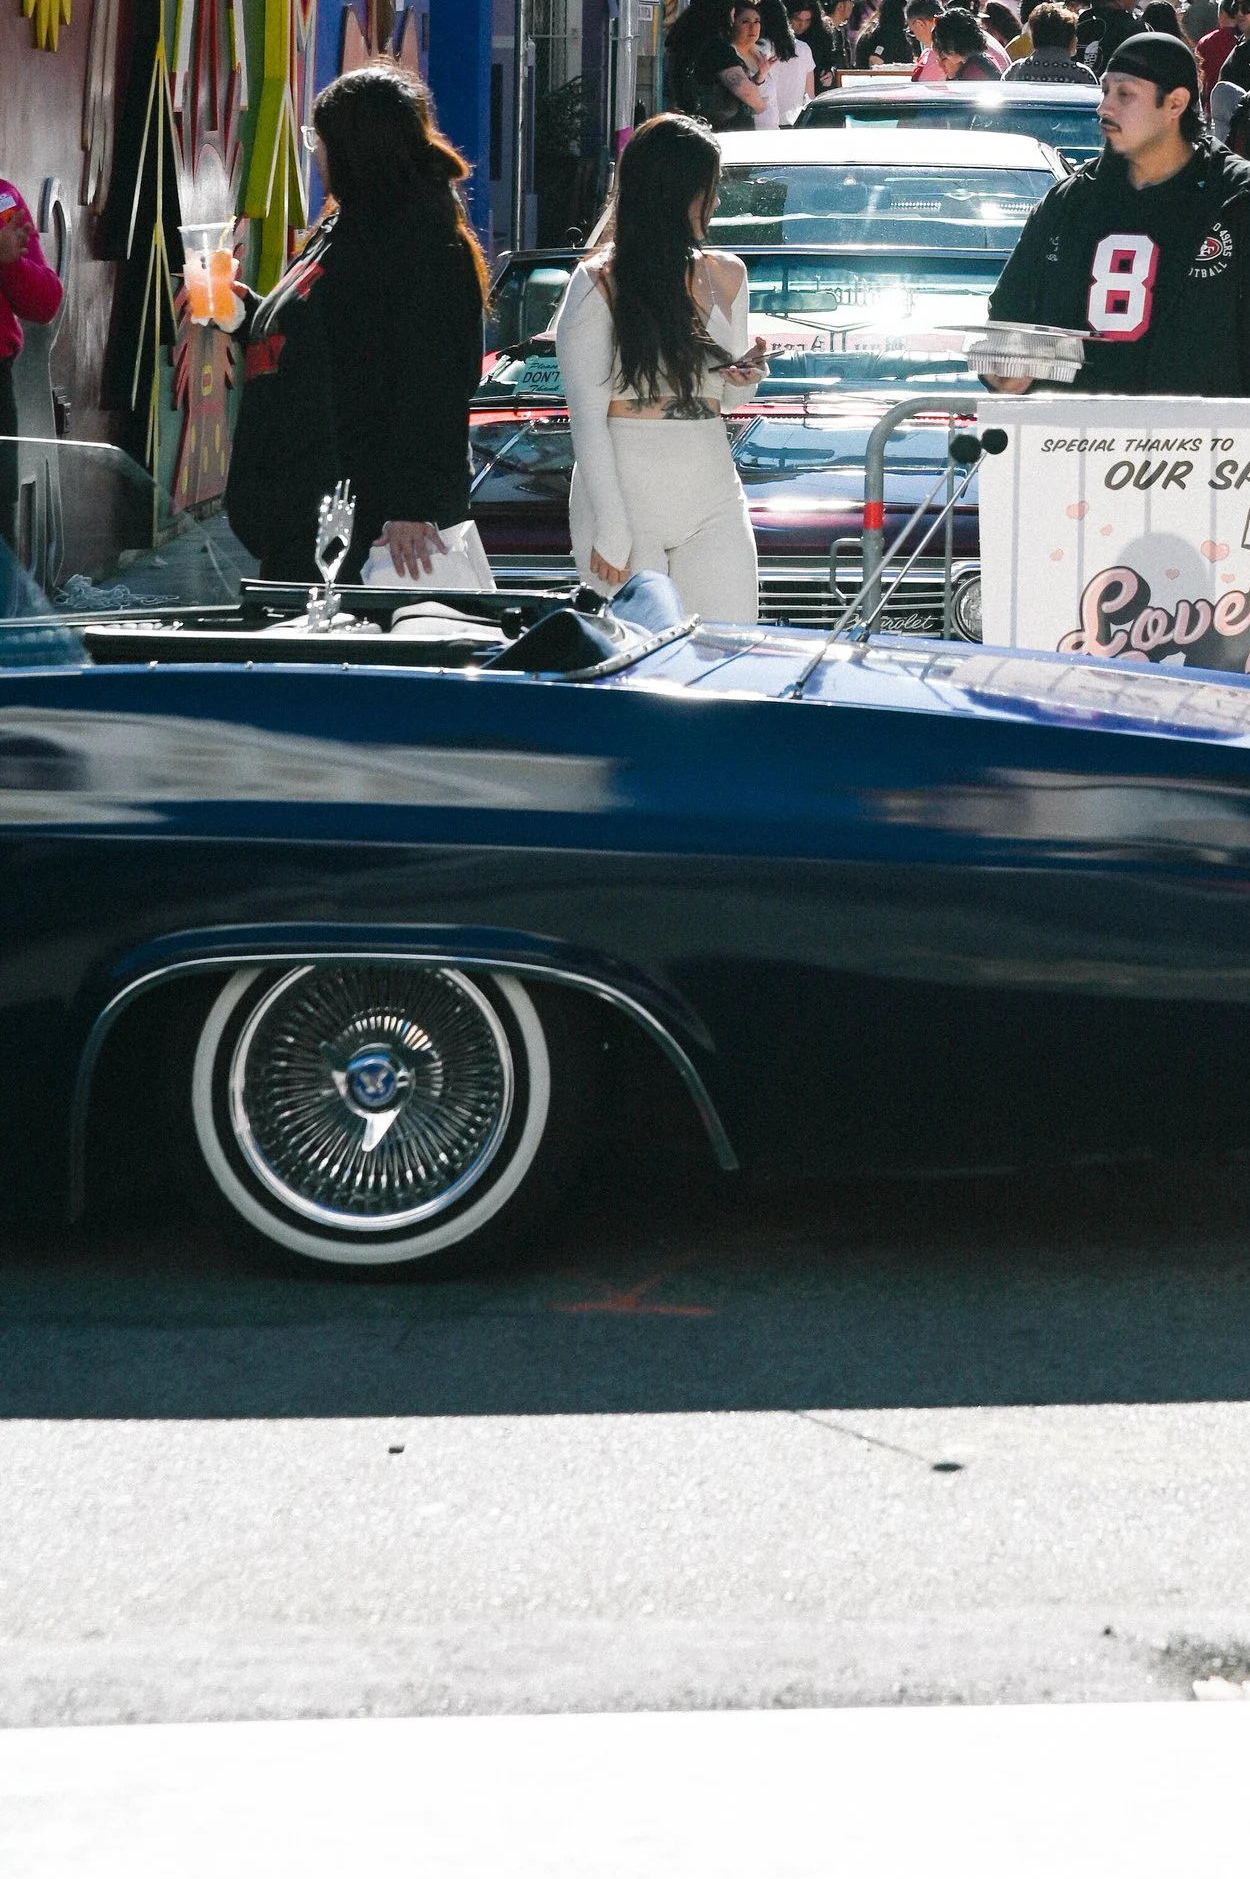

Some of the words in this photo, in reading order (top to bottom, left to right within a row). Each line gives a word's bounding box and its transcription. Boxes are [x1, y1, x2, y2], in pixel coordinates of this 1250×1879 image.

[1219, 228, 1233, 258] 49ERS
[1087, 232, 1160, 342] 8
[523, 371, 561, 383] DON'T
[1041, 438, 1115, 452] SPECIAL
[1125, 437, 1202, 452] THANKS
[1210, 437, 1235, 452] TO
[1103, 459, 1194, 491] OUR
